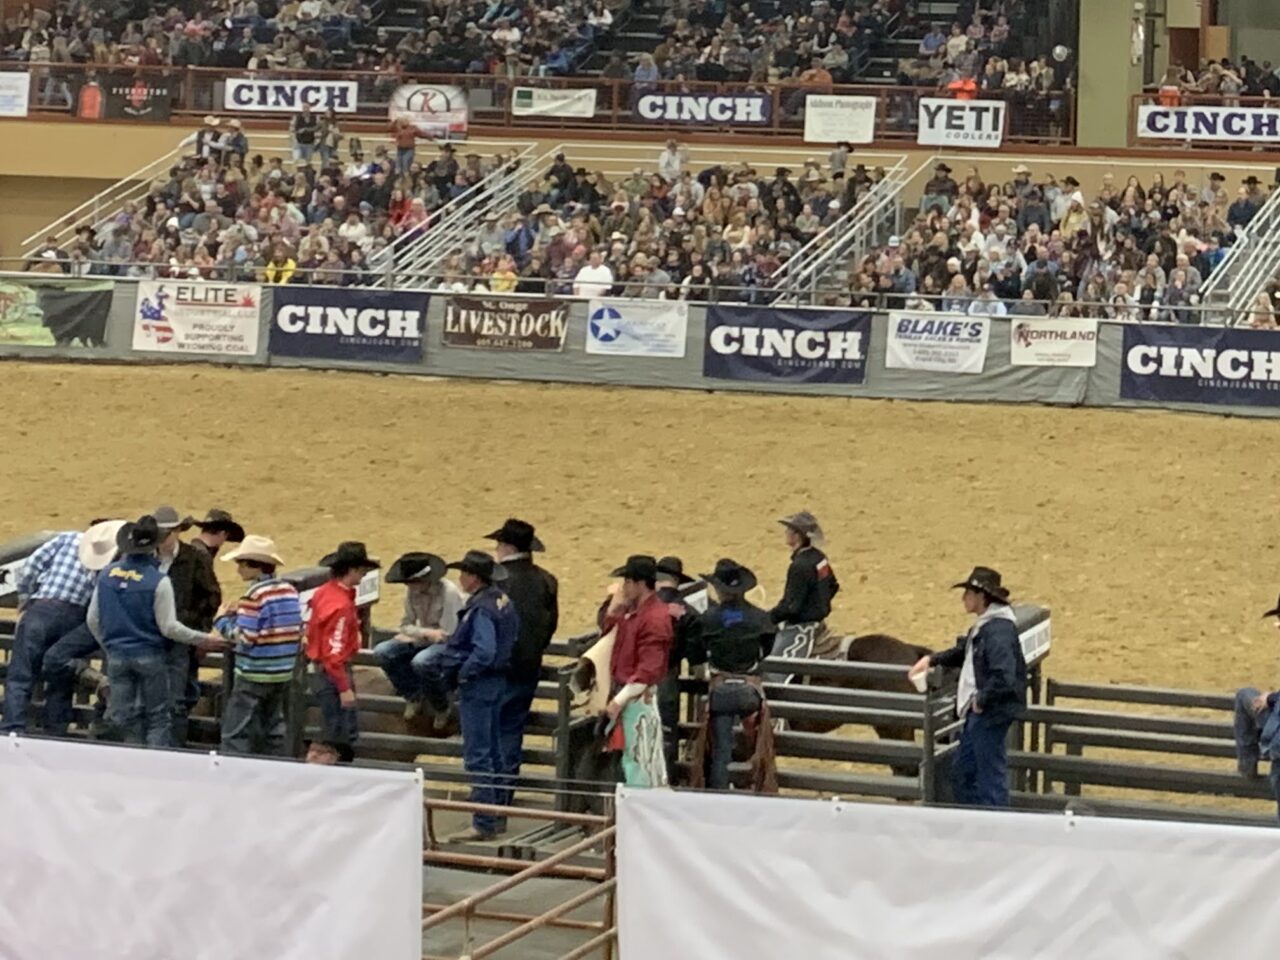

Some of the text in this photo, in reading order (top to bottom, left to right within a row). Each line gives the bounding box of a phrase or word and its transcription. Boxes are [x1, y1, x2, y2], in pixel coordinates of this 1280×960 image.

[233, 84, 349, 107] CINCH
[638, 95, 763, 121] CINCH
[922, 104, 1000, 131] YETI
[1146, 111, 1279, 136] CINCH
[945, 131, 1000, 141] COOLERS
[176, 286, 237, 303] ELITE
[277, 305, 420, 337] CINCH
[445, 305, 569, 343] LIVESTOCK
[897, 319, 983, 337] BLAKE'S
[710, 326, 861, 360] CINCH
[1018, 327, 1096, 341] NORTHLAND
